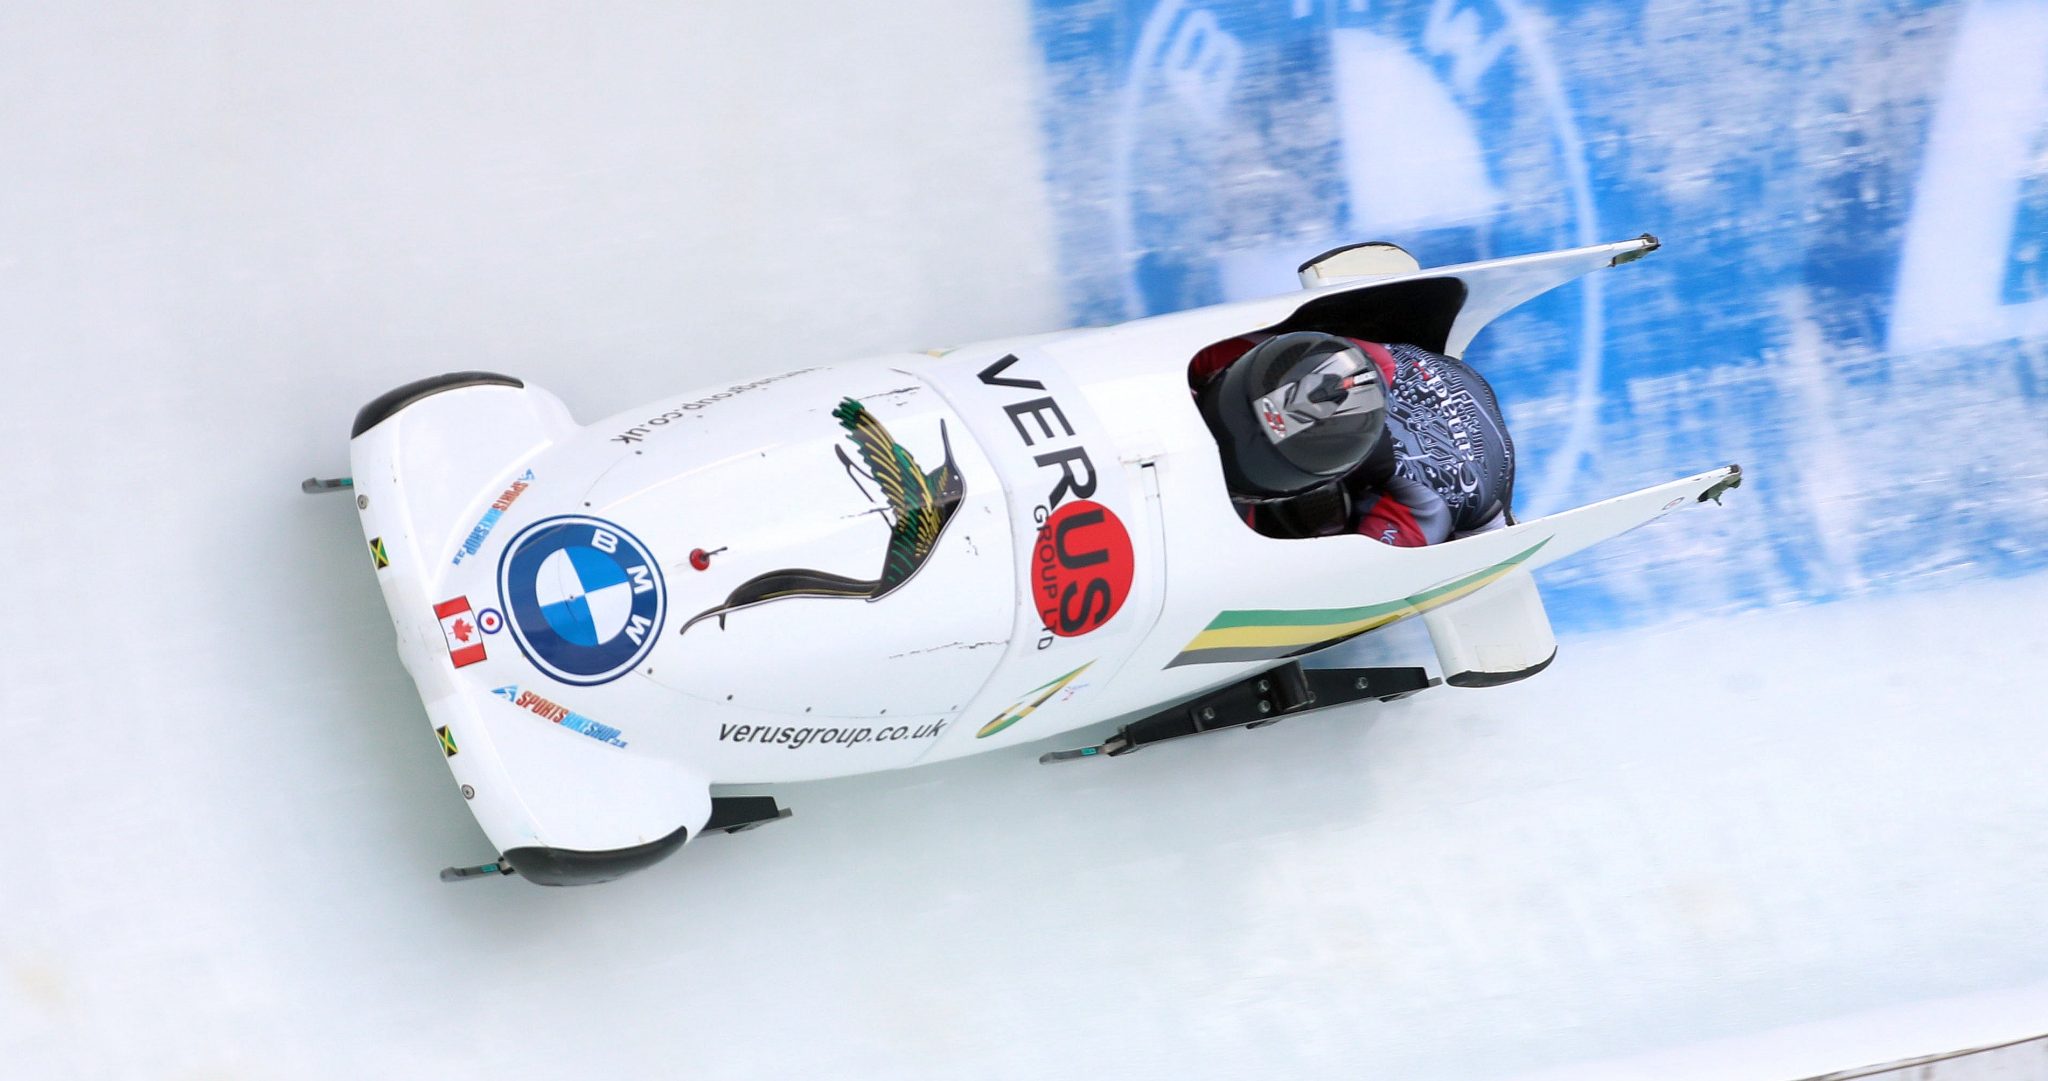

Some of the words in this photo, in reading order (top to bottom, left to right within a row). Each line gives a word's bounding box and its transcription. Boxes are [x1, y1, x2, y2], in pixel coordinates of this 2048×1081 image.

[976, 353, 1112, 634] VERUS
[591, 528, 653, 646] BMW
[1034, 504, 1058, 599] GROUP
[1037, 608, 1057, 651] LTD
[719, 718, 948, 749] verusgroup.co.uk
